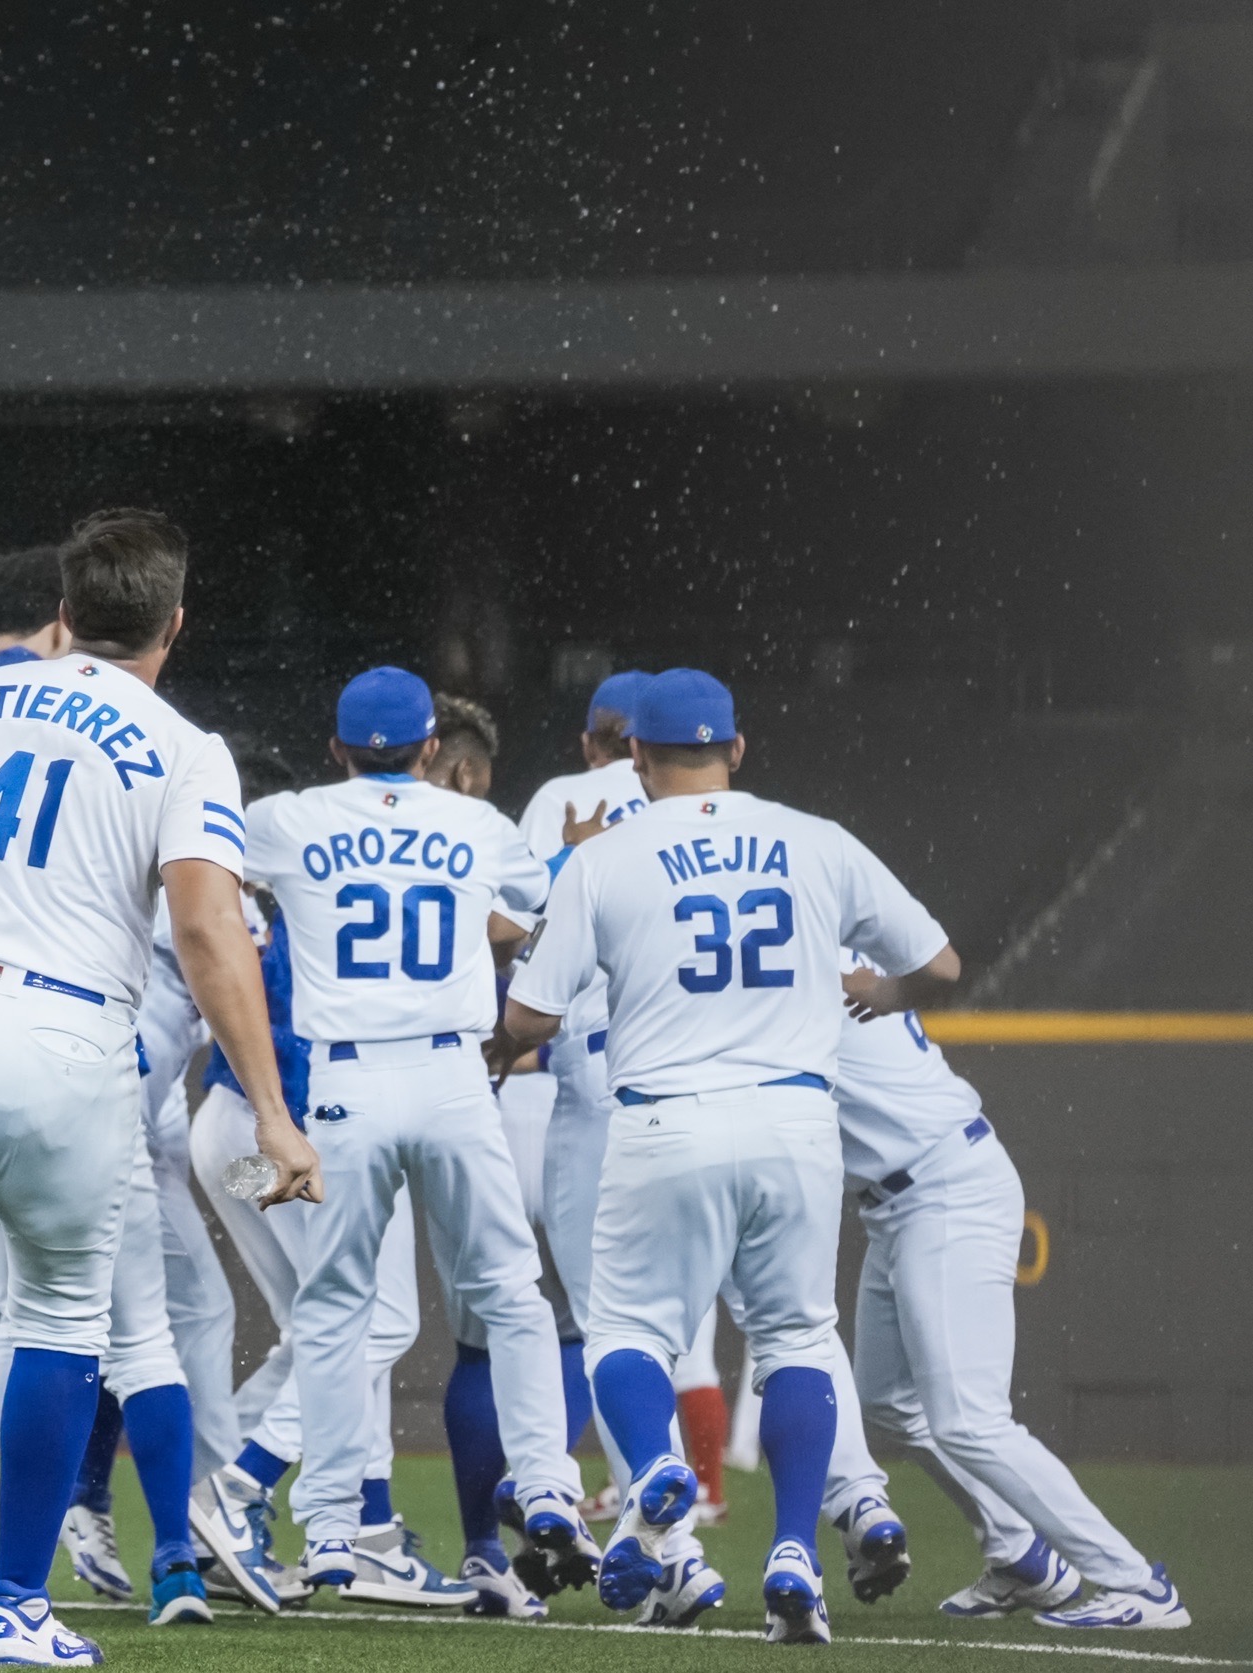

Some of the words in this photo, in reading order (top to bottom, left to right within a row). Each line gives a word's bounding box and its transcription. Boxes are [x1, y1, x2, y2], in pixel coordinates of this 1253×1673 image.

[302, 827, 474, 881] OROZCO
[657, 836, 789, 886] MEJIA
[335, 882, 457, 982] 20
[674, 887, 794, 993] 32
